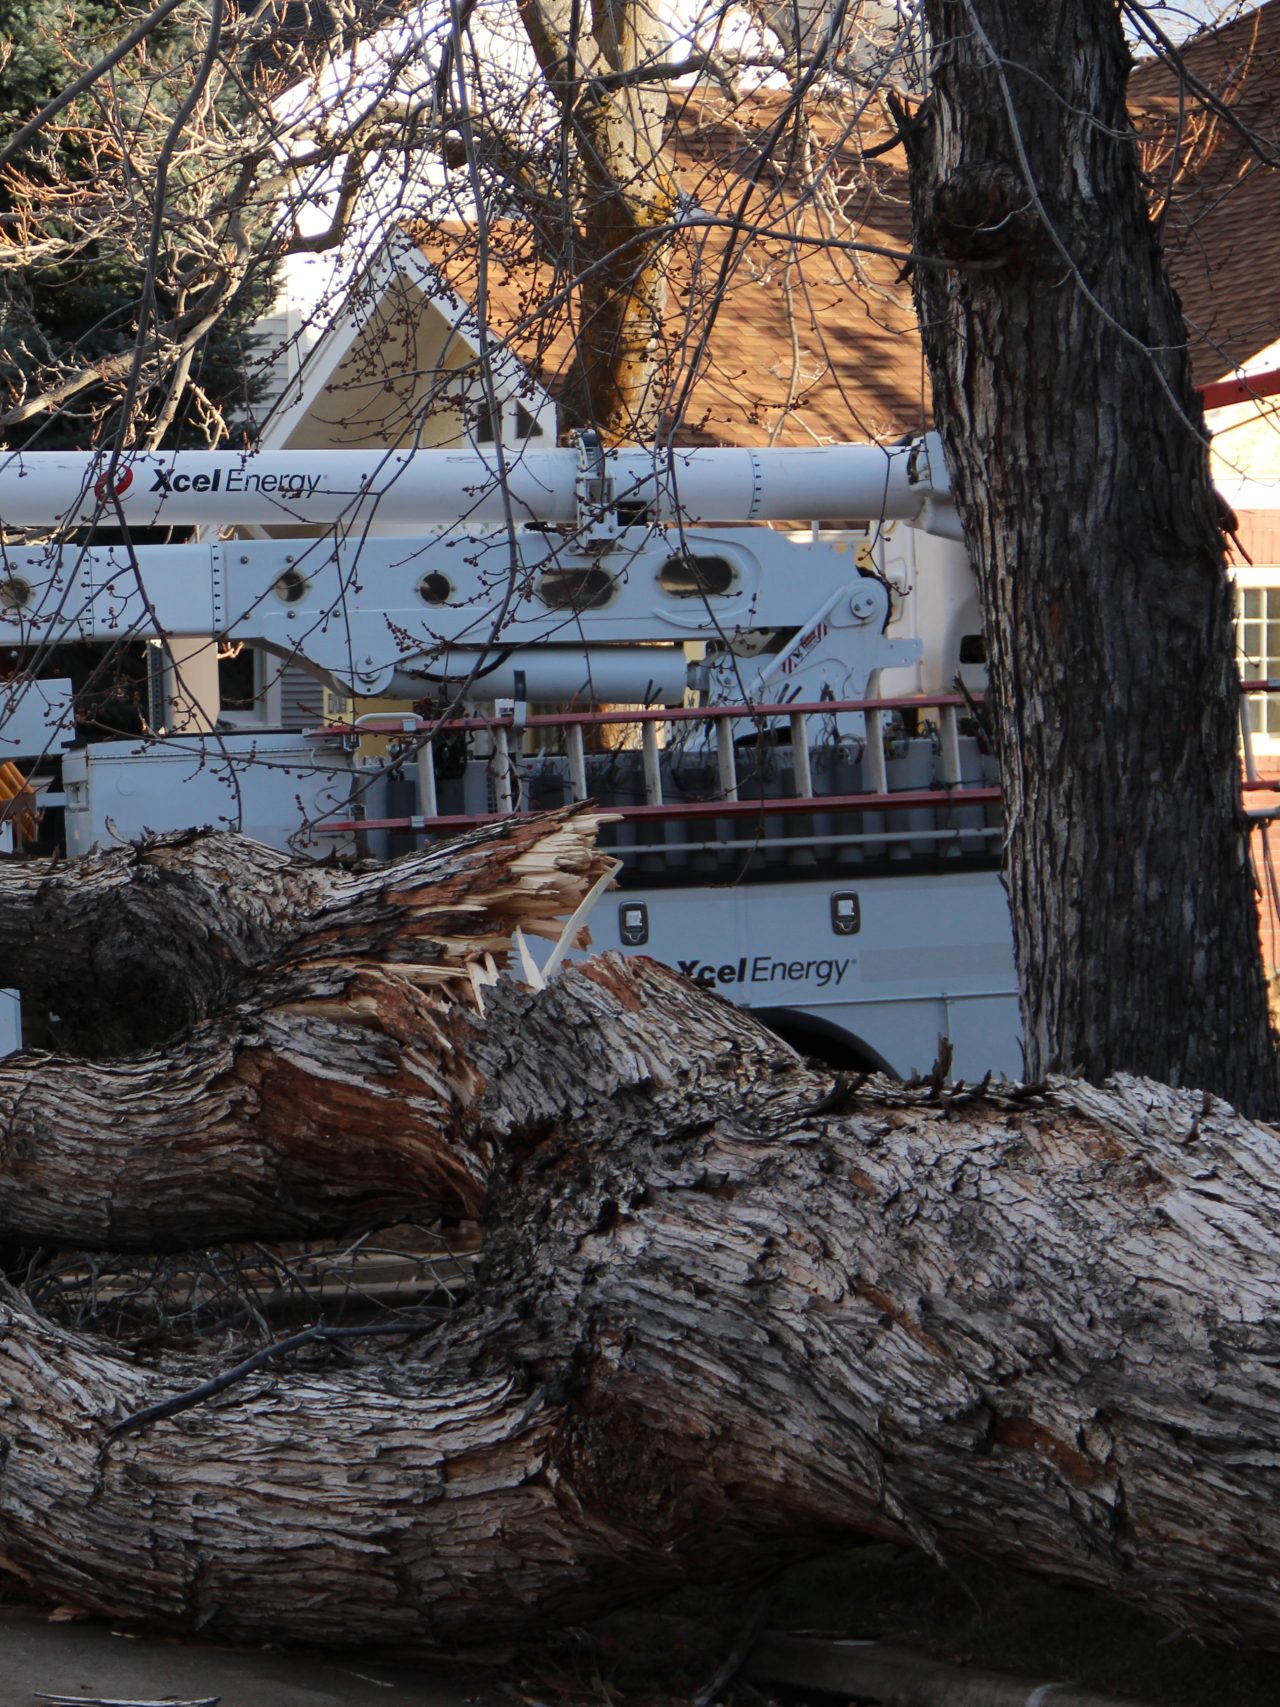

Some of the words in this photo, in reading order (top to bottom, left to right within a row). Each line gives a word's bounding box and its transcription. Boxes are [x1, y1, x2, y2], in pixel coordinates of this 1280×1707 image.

[149, 468, 222, 493] Xcel
[225, 468, 322, 499] Energy
[676, 957, 748, 985] Xcel
[751, 956, 850, 987] Energy
